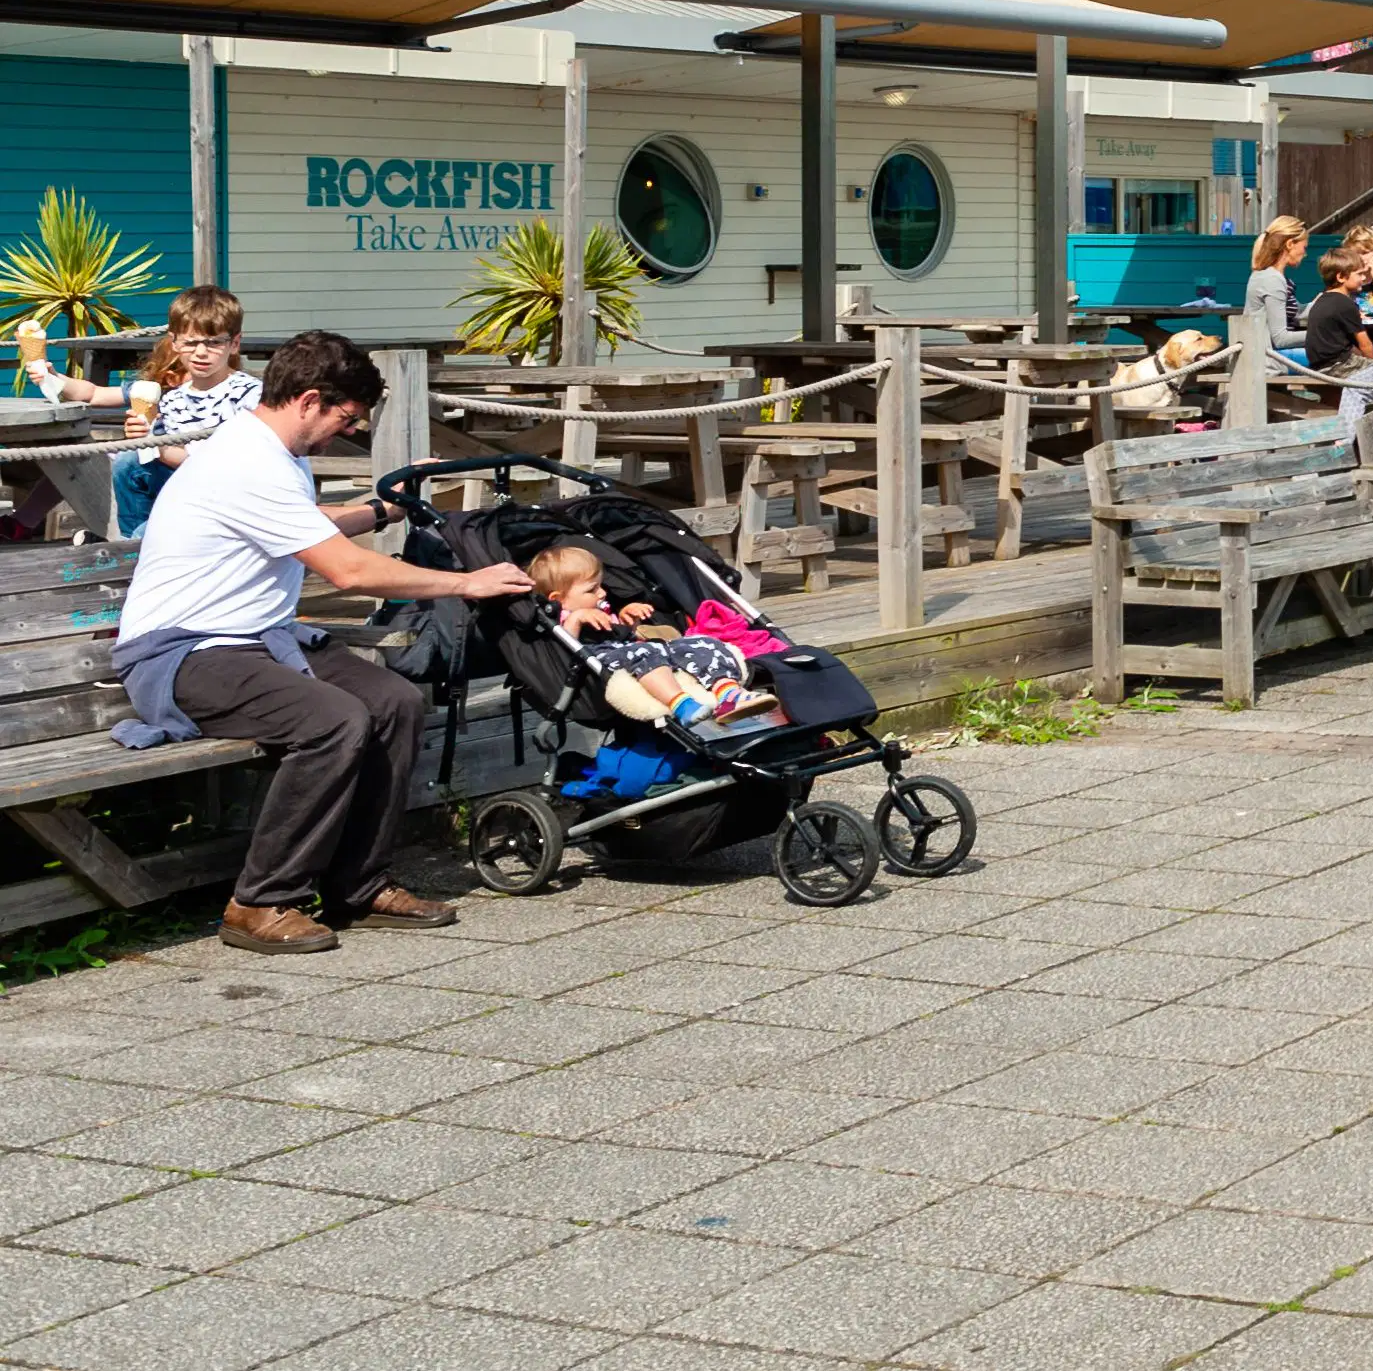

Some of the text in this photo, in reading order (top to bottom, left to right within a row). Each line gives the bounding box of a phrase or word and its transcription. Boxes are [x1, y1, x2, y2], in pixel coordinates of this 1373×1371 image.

[1096, 138, 1157, 162] Take Away
[306, 156, 556, 210] ROCKFISH
[346, 214, 427, 251] Take
